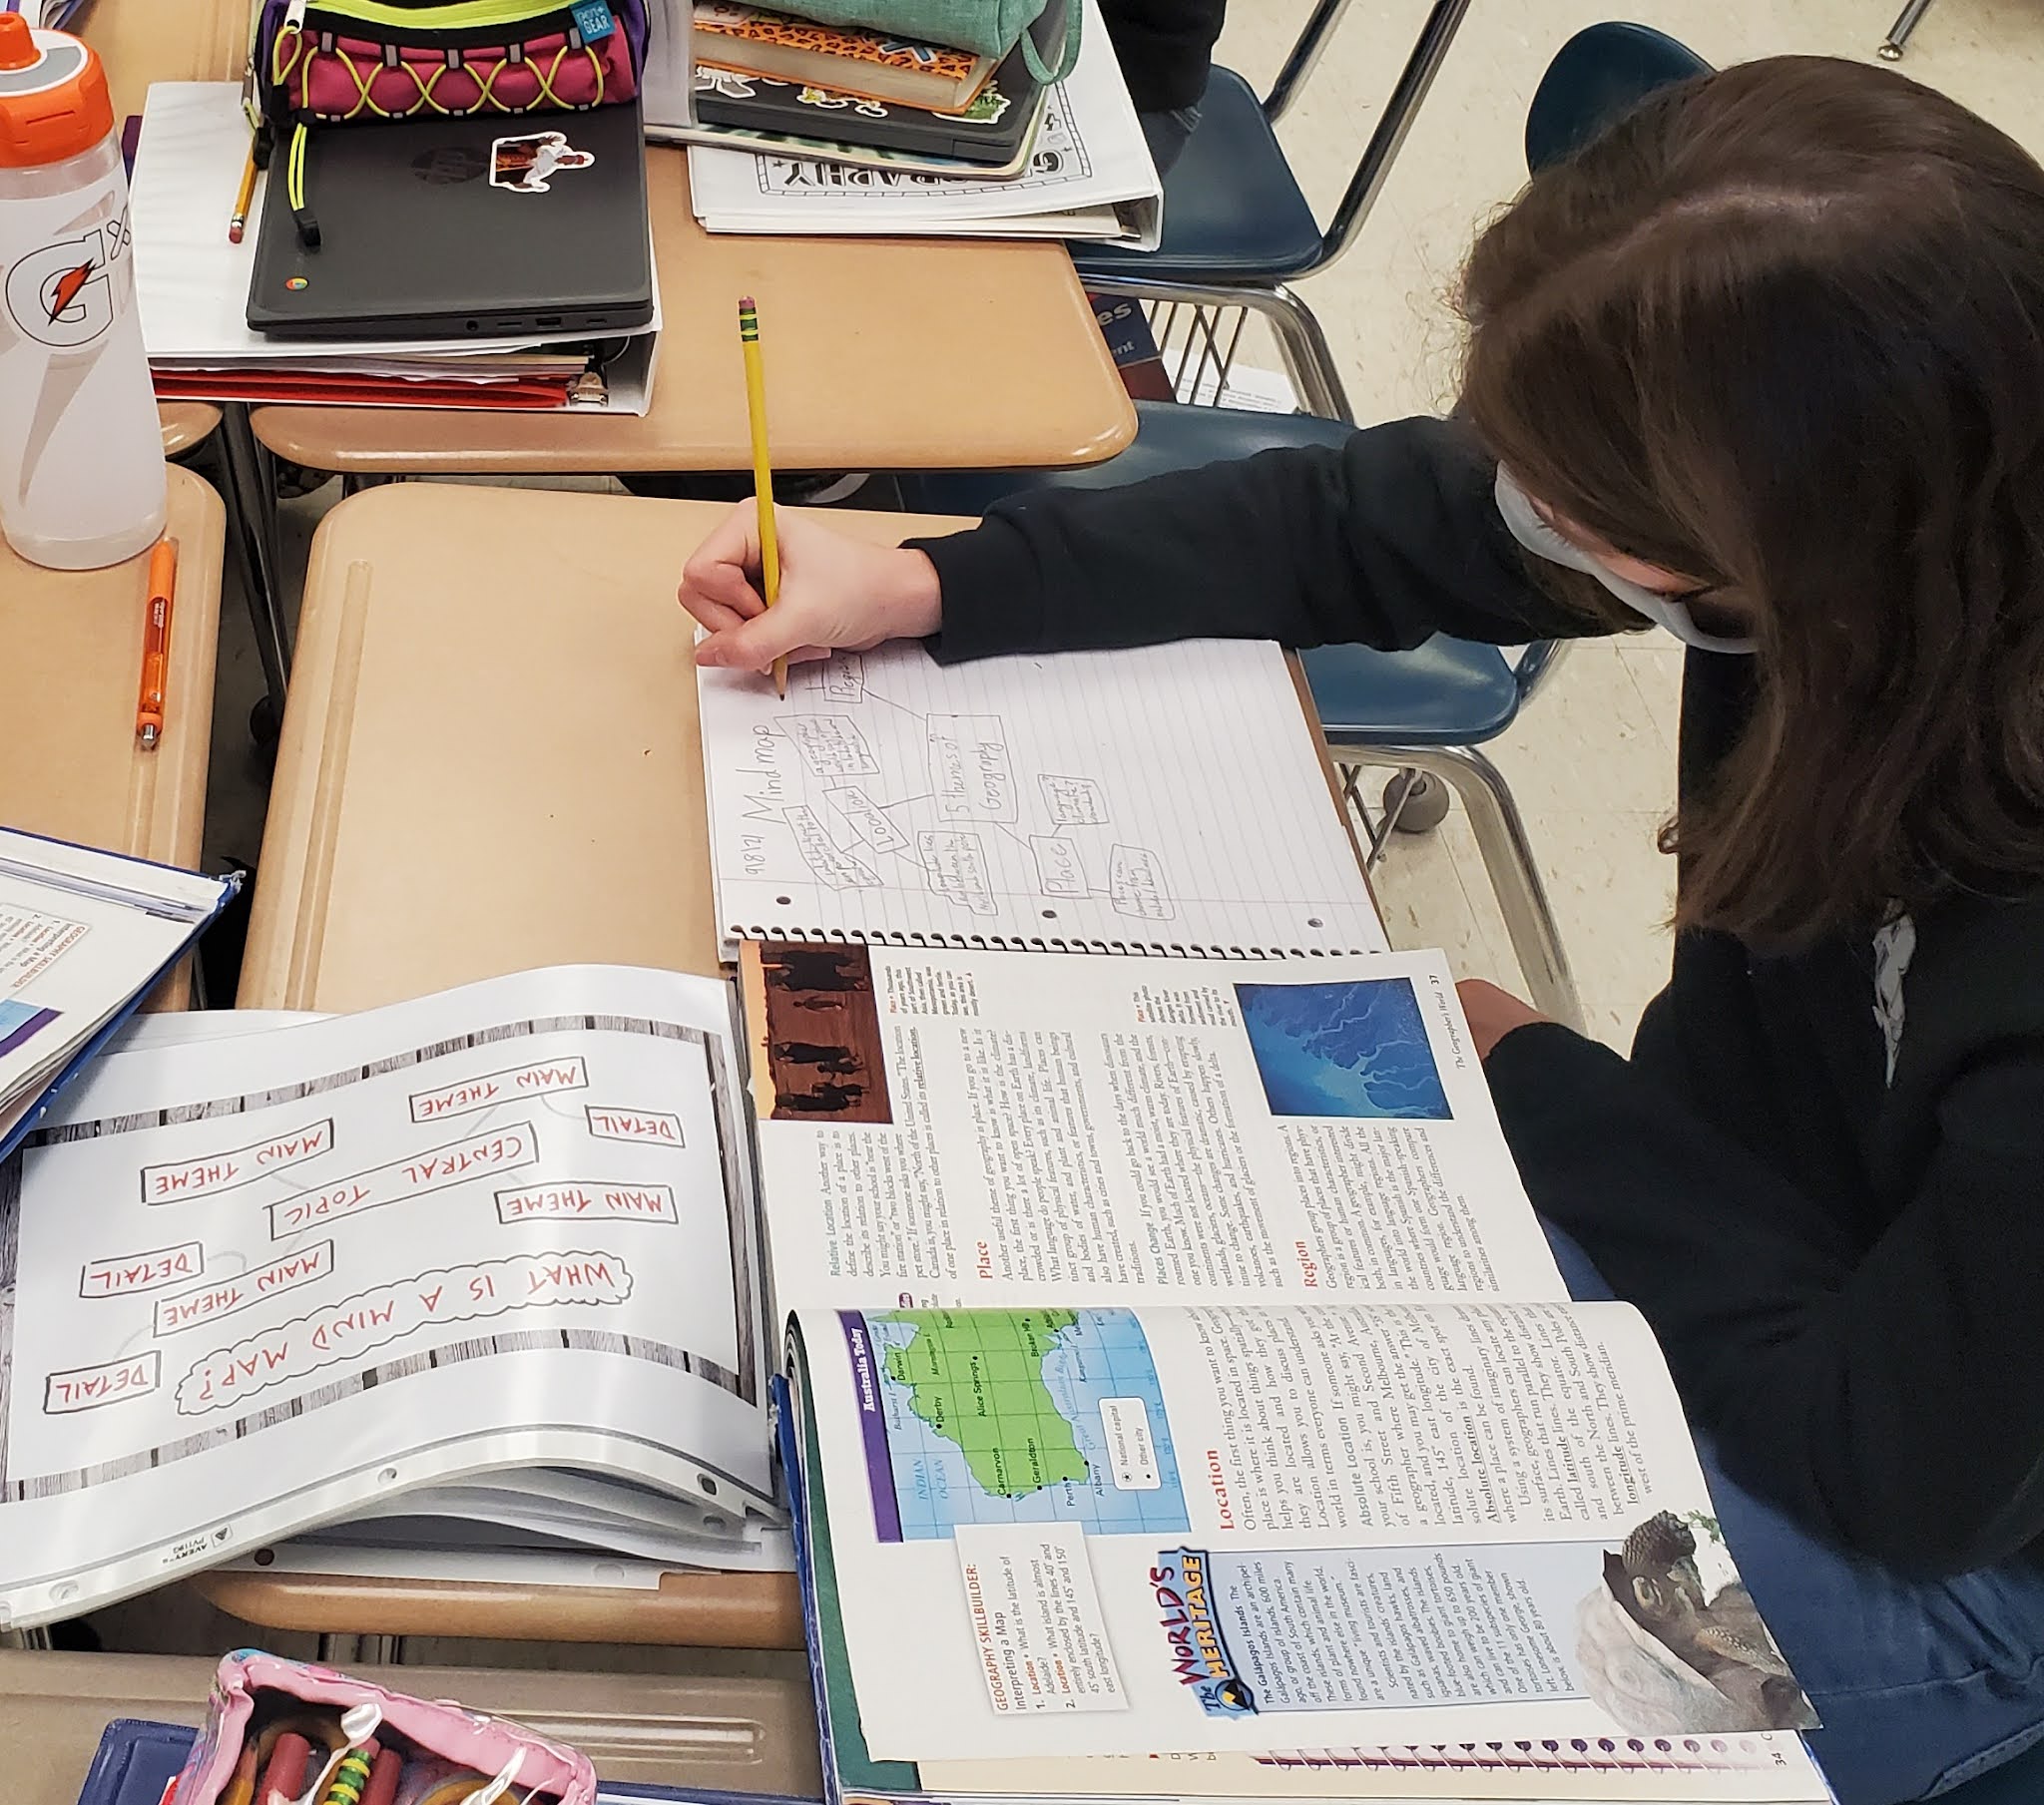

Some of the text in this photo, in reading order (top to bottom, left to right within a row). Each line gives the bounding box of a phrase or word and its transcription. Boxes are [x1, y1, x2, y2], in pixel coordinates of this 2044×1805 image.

[583, 15, 610, 34] GEAR
[929, 734, 969, 813] 5 themes of
[1044, 843, 1080, 893] Place
[1429, 975, 1439, 984] 37
[908, 1026, 924, 1090] relative location.
[418, 1066, 576, 1117] MAIN THEME
[592, 1116, 676, 1139] DETAIL
[971, 1102, 985, 1124] place.
[156, 1130, 322, 1195] MAIN THEME
[977, 1133, 995, 1175] geography
[1283, 1133, 1299, 1164] regions.
[283, 1136, 522, 1225] CENTRAL TOPIC
[983, 1175, 996, 1186] of
[1292, 1166, 1304, 1182] into
[507, 1189, 661, 1215] MAIN THEME
[816, 1129, 841, 1276] Relative Location Another way to
[989, 1187, 1001, 1213] theme
[1298, 1184, 1315, 1208] places
[992, 1215, 1006, 1241] useful
[1306, 1210, 1324, 1233] group
[91, 1253, 192, 1289] DETAIL
[976, 1241, 992, 1279] Place
[999, 1243, 1013, 1281] Another
[1146, 1222, 1169, 1285] Places Change
[1293, 1241, 1317, 1287] Region
[1315, 1235, 1337, 1288] Geographers
[164, 1252, 319, 1325] MAIN THEME
[200, 1263, 615, 1400] WHAT IS A MIND MAP?
[56, 1365, 148, 1403] DETAIL
[850, 1328, 875, 1411] Australia Today
[893, 1353, 905, 1381] Darwin
[969, 1361, 986, 1417] Alice Springs
[932, 1397, 944, 1423] Derby
[1196, 1320, 1257, 1531] Often, the first thing you want to know
[1110, 1405, 1129, 1466] National capital
[1134, 1427, 1149, 1466] Other city
[992, 1447, 1006, 1495] Carnarvon
[1026, 1438, 1042, 1483] Geraldton
[1338, 1417, 1373, 1527] Absolute Location
[1463, 1416, 1499, 1523] Absolute location
[1557, 1436, 1578, 1483] latitude
[1614, 1445, 1639, 1504] longitude
[913, 1459, 928, 1501] INDIAN
[934, 1459, 948, 1499] OCEAN
[1064, 1483, 1075, 1507] Perth
[1092, 1464, 1104, 1497] Albany
[1206, 1450, 1235, 1530] Location
[999, 1557, 1011, 1566] of
[1040, 1544, 1055, 1561] and
[1003, 1568, 1017, 1599] latitude
[1030, 1560, 1044, 1588] almost
[1048, 1577, 1062, 1597] lines
[1059, 1567, 1071, 1583] and
[1011, 1602, 1021, 1616] the
[1054, 1599, 1064, 1614] the
[1230, 1585, 1240, 1599] The
[994, 1611, 1007, 1635] Map
[1038, 1599, 1052, 1624] island
[1058, 1615, 1069, 1626] by
[1068, 1606, 1081, 1621] and
[1182, 1556, 1230, 1678] HERITAGE
[1236, 1605, 1252, 1636] Islands
[966, 1564, 1008, 1710] GEOGRAPHY SKILLBUILDER:
[1016, 1627, 1029, 1650] What
[1045, 1626, 1058, 1649] What
[1060, 1627, 1077, 1663] enclosed
[1074, 1624, 1089, 1655] latitude
[1150, 1567, 1221, 1710] The WORLD'S
[1003, 1649, 1026, 1709] Interpreting
[1025, 1660, 1042, 1695] Location
[1037, 1656, 1056, 1694] Adelaide?
[1055, 1659, 1071, 1694] Location
[1070, 1665, 1086, 1694] entirely
[1082, 1657, 1097, 1679] south
[1090, 1632, 1116, 1693] east longitude?
[1066, 1699, 1076, 1708] 2.
[1264, 1688, 1276, 1704] The
[1772, 1753, 1787, 1765] 34
